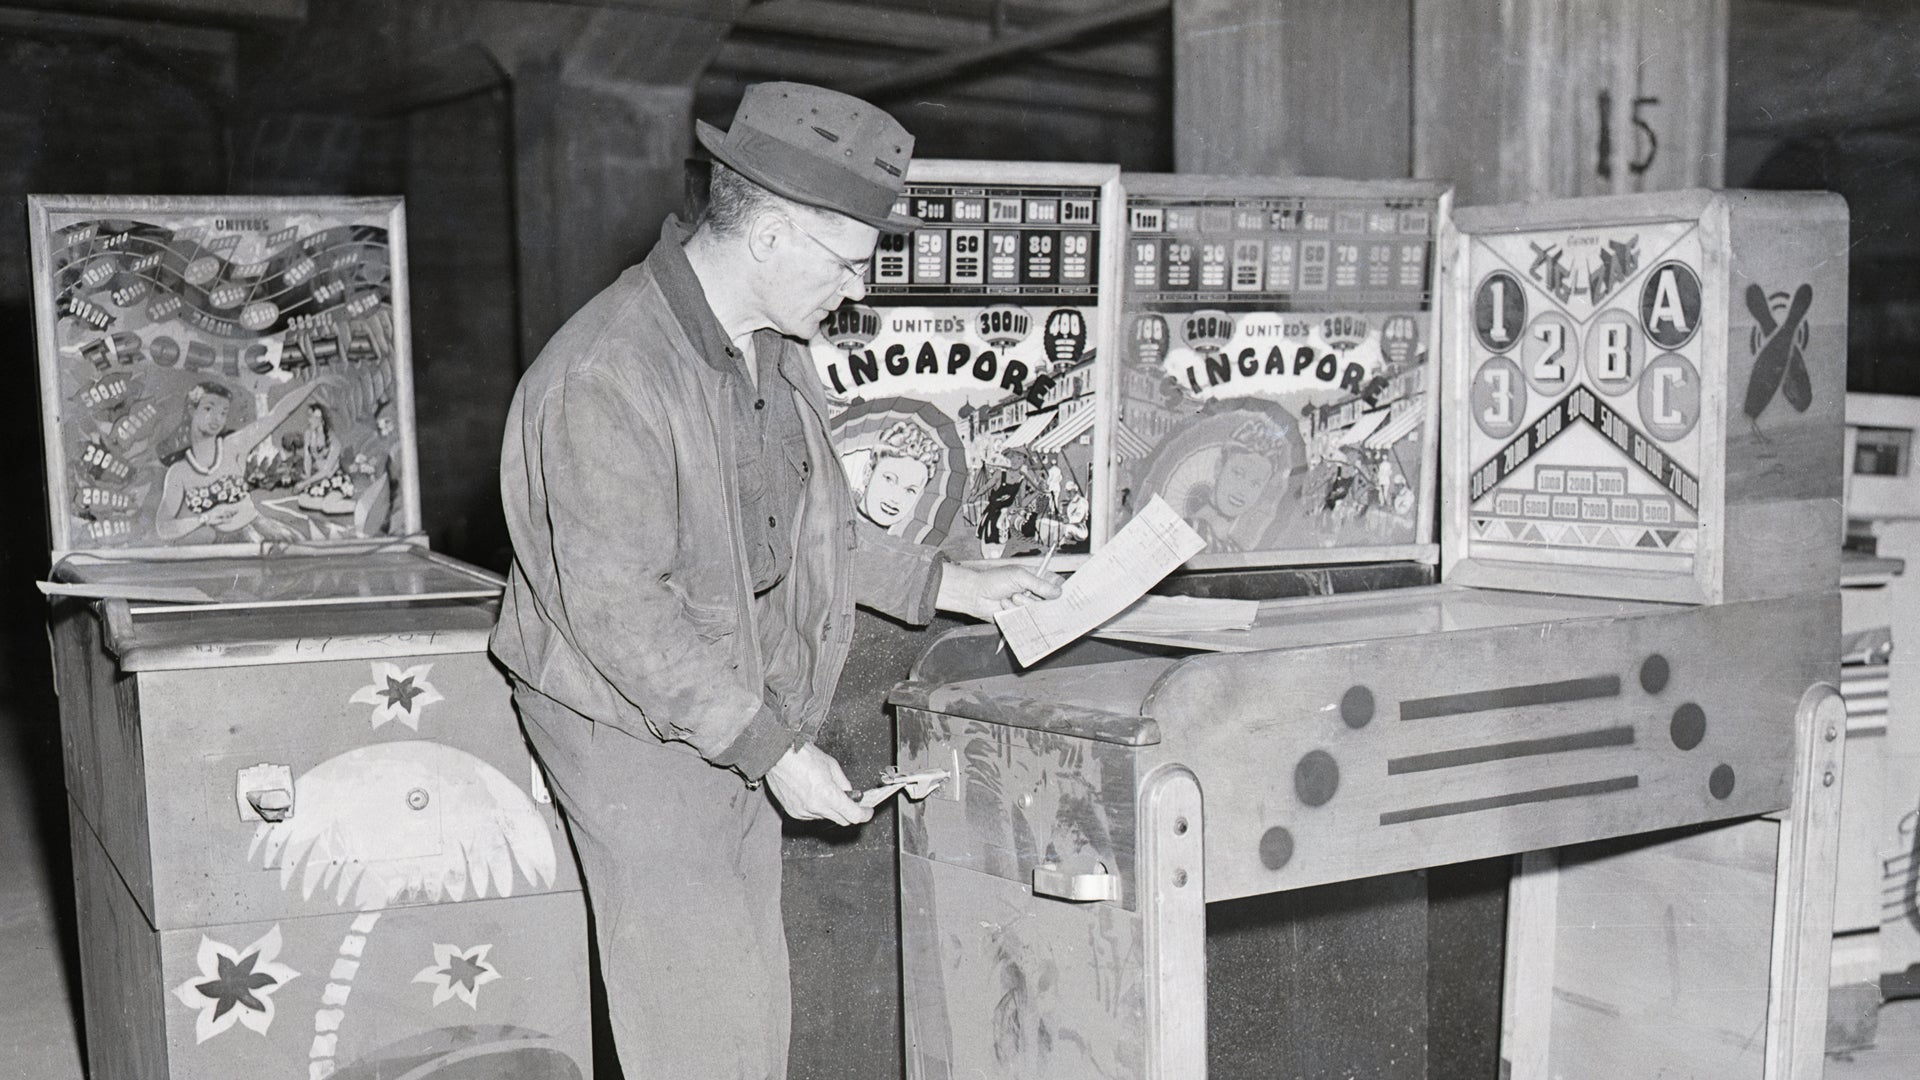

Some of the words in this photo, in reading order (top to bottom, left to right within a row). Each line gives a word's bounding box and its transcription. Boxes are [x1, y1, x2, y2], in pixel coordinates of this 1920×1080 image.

[1598, 90, 1658, 178] 15
[917, 200, 945, 218] 5000
[955, 201, 982, 219] 6000
[993, 202, 1018, 219] 7000
[1028, 202, 1055, 220] 8000
[1065, 203, 1091, 219] 9000
[1136, 212, 1157, 228] 1000
[893, 315, 966, 333] UNITED'S
[1246, 320, 1310, 337] UNITED'S
[1490, 281, 1510, 342] 1
[1650, 268, 1691, 333] A
[828, 341, 1056, 410] INGAPORE
[1534, 323, 1565, 382] 2
[1599, 322, 1631, 382] B
[1484, 368, 1514, 425] 3
[1653, 366, 1687, 425] C
